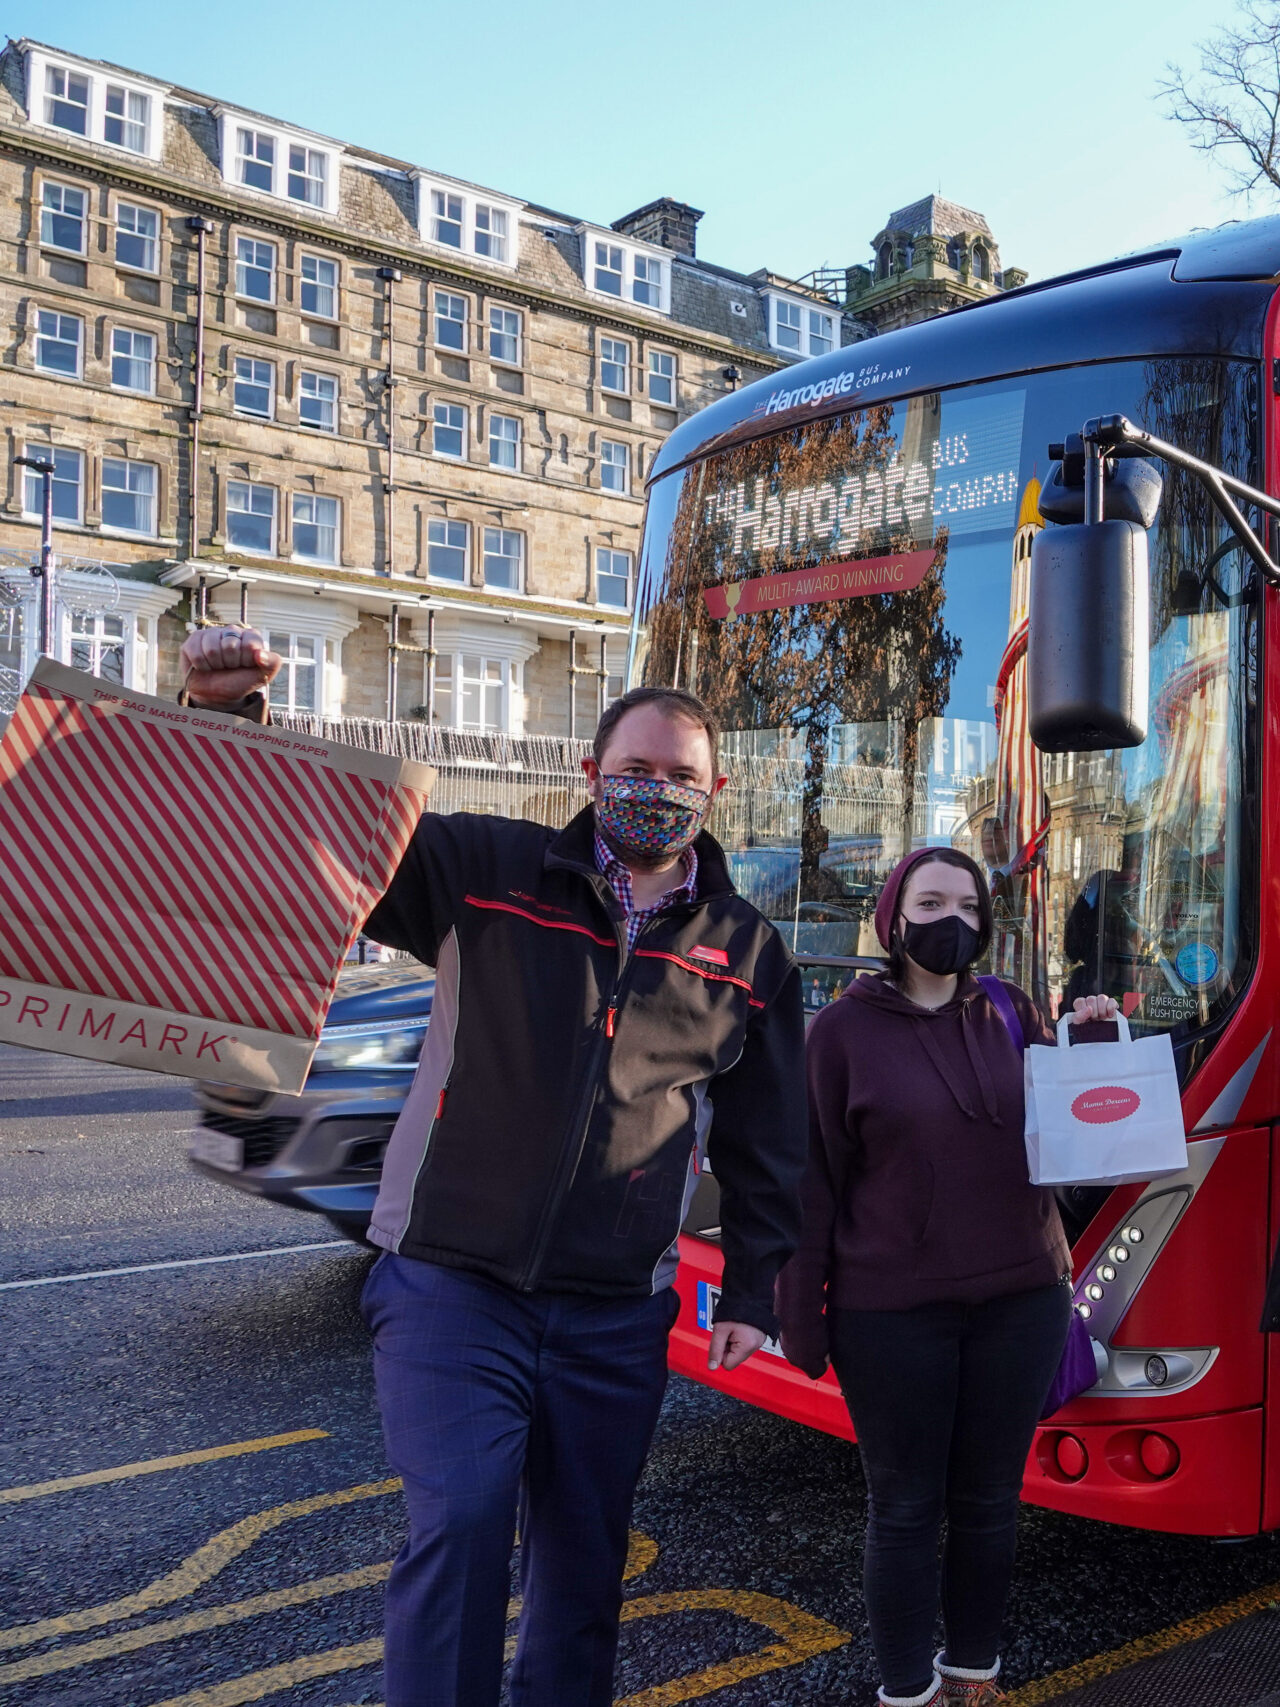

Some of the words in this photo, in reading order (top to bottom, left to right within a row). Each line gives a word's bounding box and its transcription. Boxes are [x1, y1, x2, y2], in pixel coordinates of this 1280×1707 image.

[765, 371, 855, 416] Harrogate
[859, 364, 880, 378] BUS
[856, 365, 912, 389] COMPANY
[705, 489, 736, 525] THE
[734, 450, 930, 556] Harrogate
[931, 432, 969, 469] BUS
[757, 574, 840, 602] MULTI-AWARD
[842, 564, 904, 589] WINNING
[92, 688, 118, 705] THIS
[121, 698, 147, 713] BAG
[148, 706, 188, 723] MAKES
[191, 718, 230, 732] GREAT
[232, 727, 290, 749] WRAPPING
[293, 742, 329, 758] PAPER
[1150, 995, 1199, 1009] EMERGENCY
[1150, 1007, 1171, 1018] PUSH
[1172, 1009, 1183, 1020] TO
